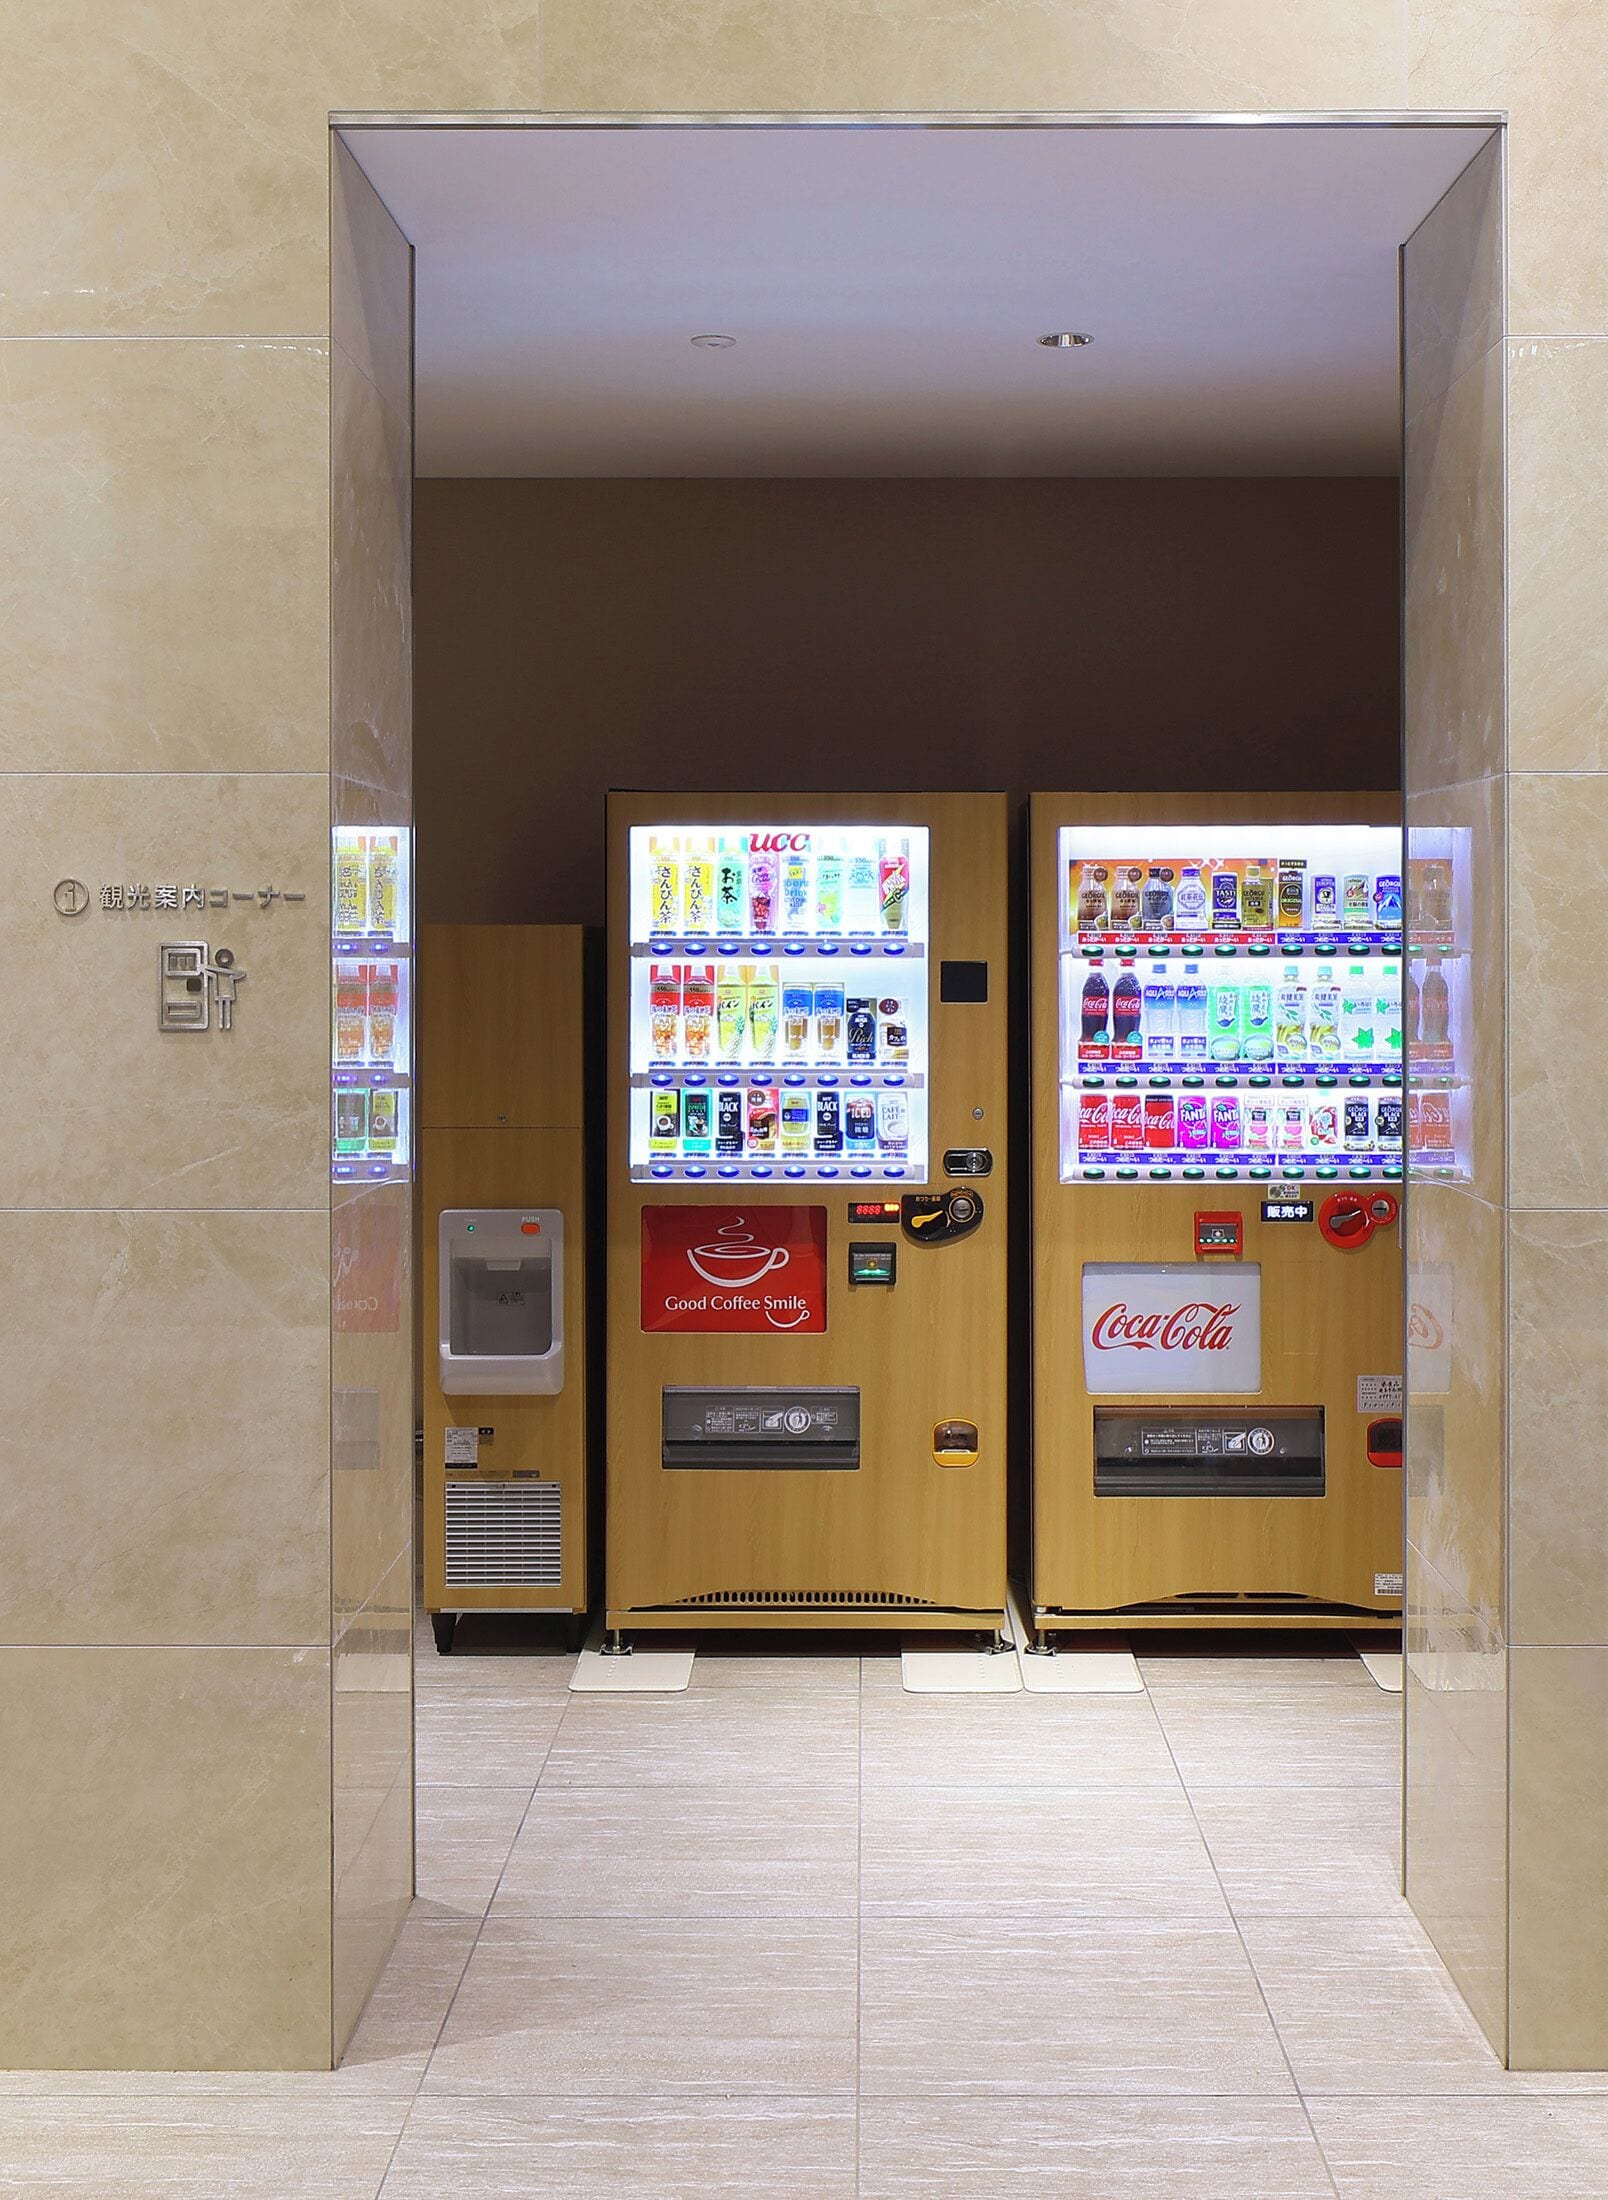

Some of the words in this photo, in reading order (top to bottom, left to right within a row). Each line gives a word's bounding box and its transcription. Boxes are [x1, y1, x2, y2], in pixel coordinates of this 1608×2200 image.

[721, 867, 738, 904] お茶
[99, 883, 306, 911] 観光案内コーナー
[851, 1107, 872, 1119] ICED
[1266, 1205, 1308, 1218] 販売中
[665, 1296, 707, 1311] Good
[711, 1295, 760, 1311] Coffee
[764, 1296, 806, 1310] Smile
[1091, 1303, 1242, 1351] Coca-Cola
